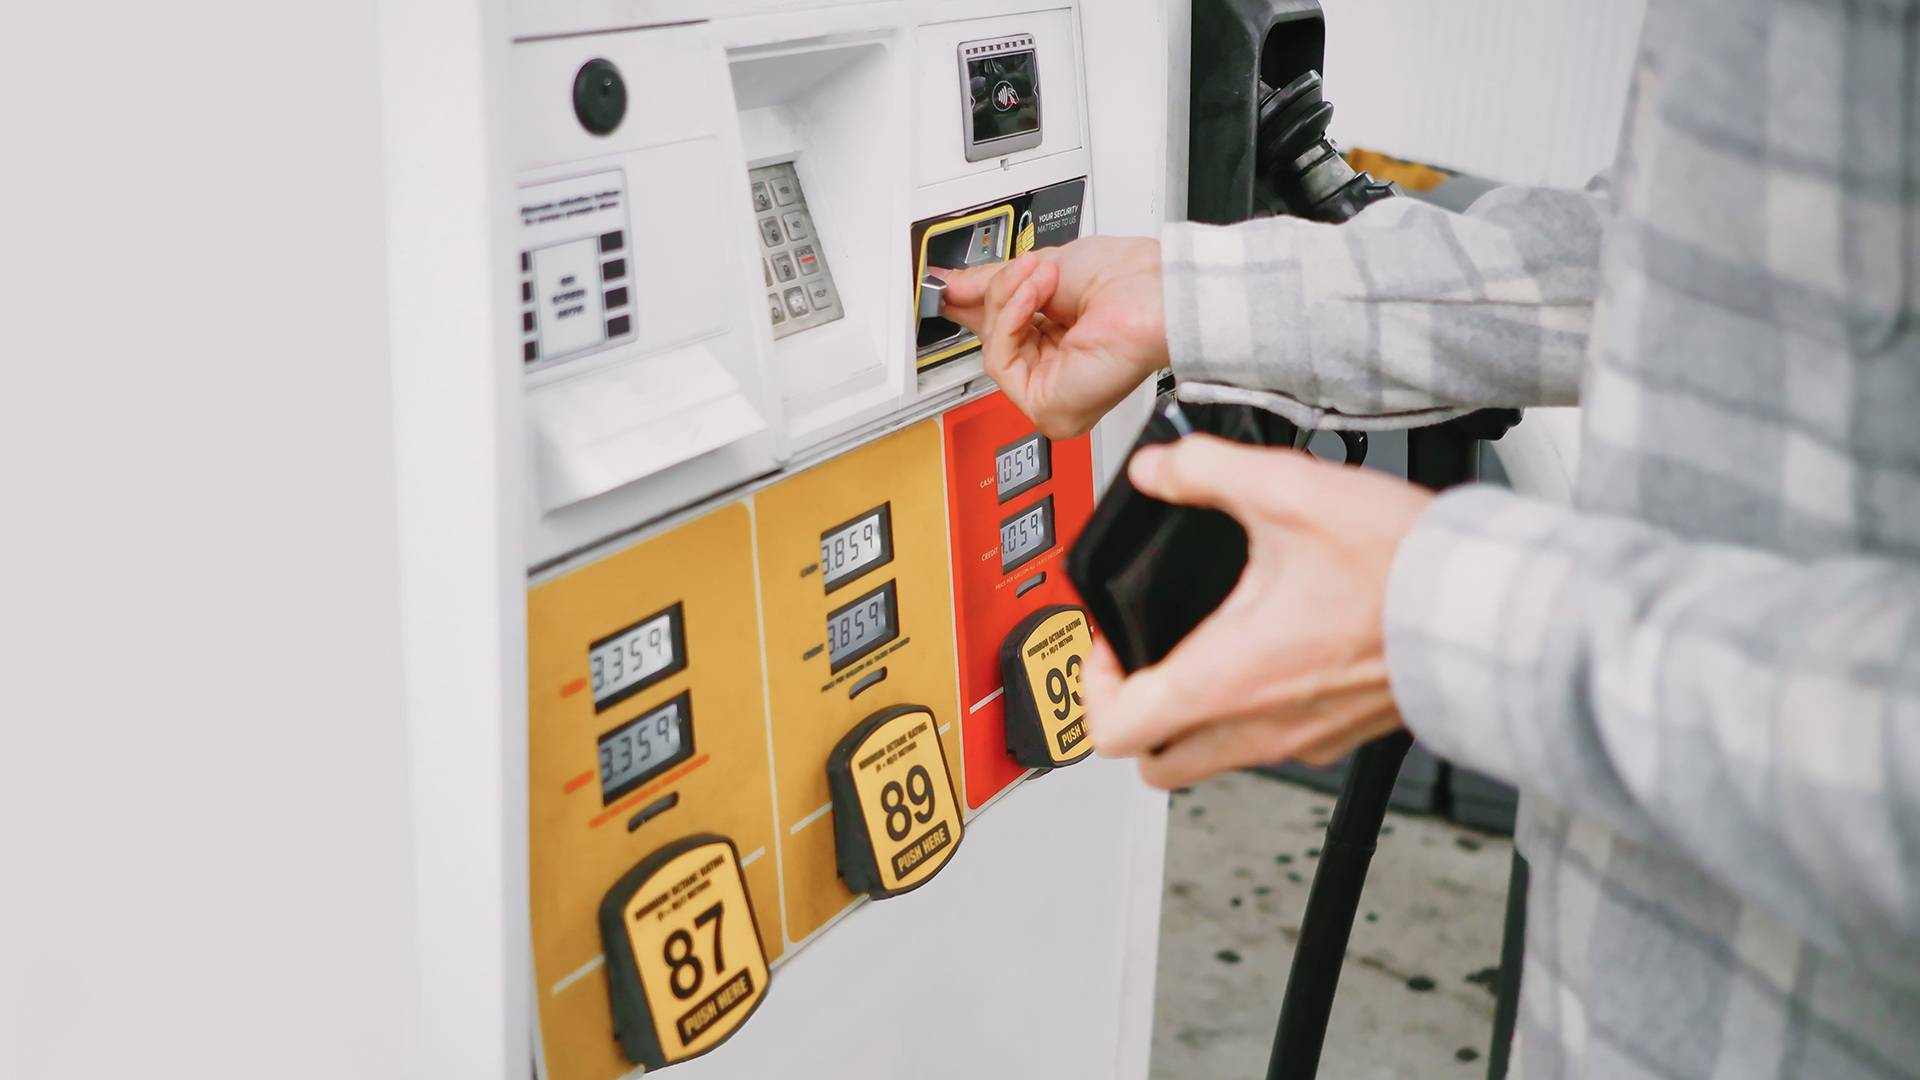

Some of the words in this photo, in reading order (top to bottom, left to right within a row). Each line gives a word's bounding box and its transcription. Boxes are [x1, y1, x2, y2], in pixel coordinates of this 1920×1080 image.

[1037, 221, 1061, 233] MATTERS
[1038, 212, 1053, 223] YOUR
[1054, 205, 1078, 218] SECURITY
[980, 477, 994, 489] CASH
[822, 523, 873, 575] 3.859
[981, 547, 998, 562] CREDIT
[828, 601, 879, 655] 3.859
[1048, 627, 1066, 644] OCTANE
[1065, 617, 1082, 633] RATING
[592, 627, 662, 693] 3.359
[601, 715, 670, 783] 3.359
[1061, 724, 1081, 747] PUSH
[881, 764, 935, 842] 89
[897, 846, 923, 873] PUSH
[922, 828, 947, 855] HERE
[663, 901, 725, 1000] 87
[684, 1001, 718, 1037] PUSH
[717, 975, 749, 1012] HERE
